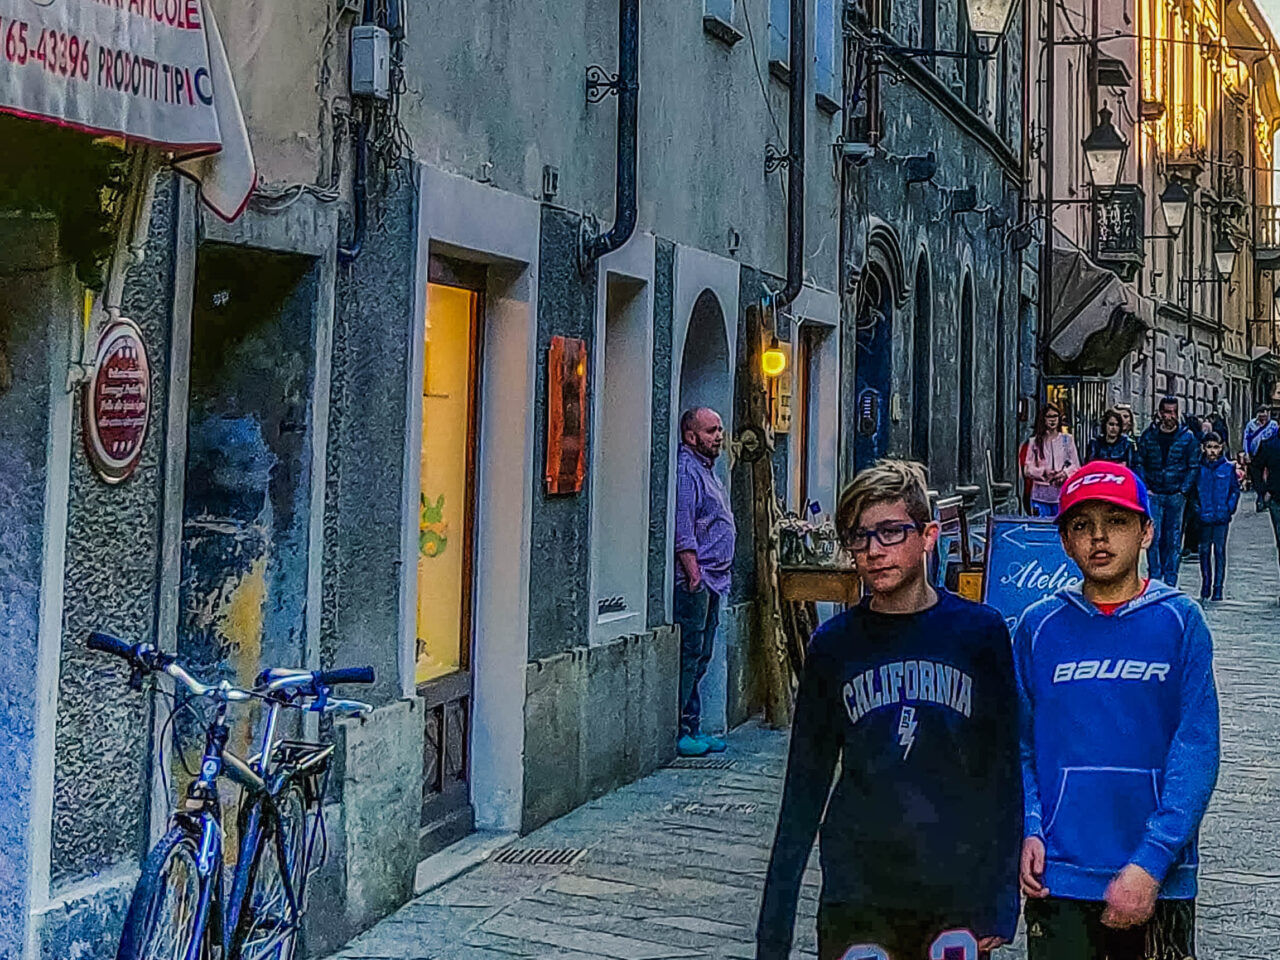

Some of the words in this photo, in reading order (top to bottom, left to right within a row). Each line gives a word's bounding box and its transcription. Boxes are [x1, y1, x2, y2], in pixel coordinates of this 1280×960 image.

[97, 45, 158, 101] PRODOTTI
[1067, 473, 1126, 495] CCM
[1053, 658, 1171, 684] BAUER
[843, 660, 973, 724] CALIFORNIA
